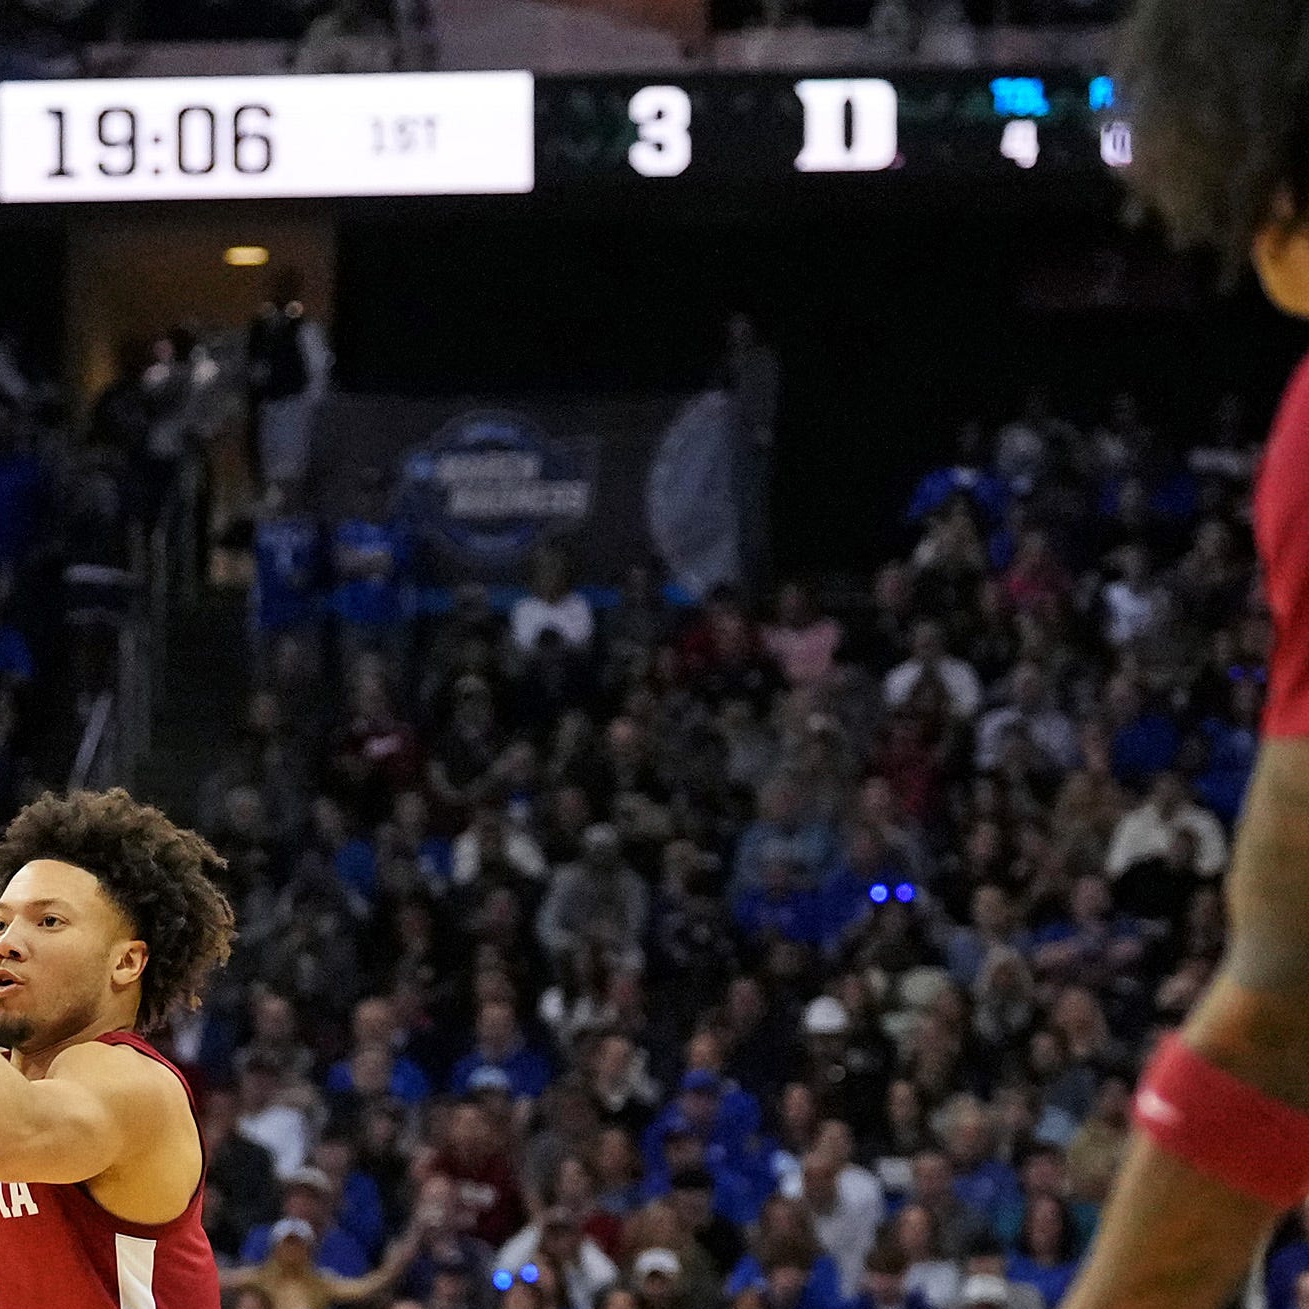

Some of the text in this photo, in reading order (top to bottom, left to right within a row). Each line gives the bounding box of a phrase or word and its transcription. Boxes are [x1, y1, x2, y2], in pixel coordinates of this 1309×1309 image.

[46, 104, 274, 180] 19:06
[627, 84, 693, 178] 3
[793, 77, 900, 172] D
